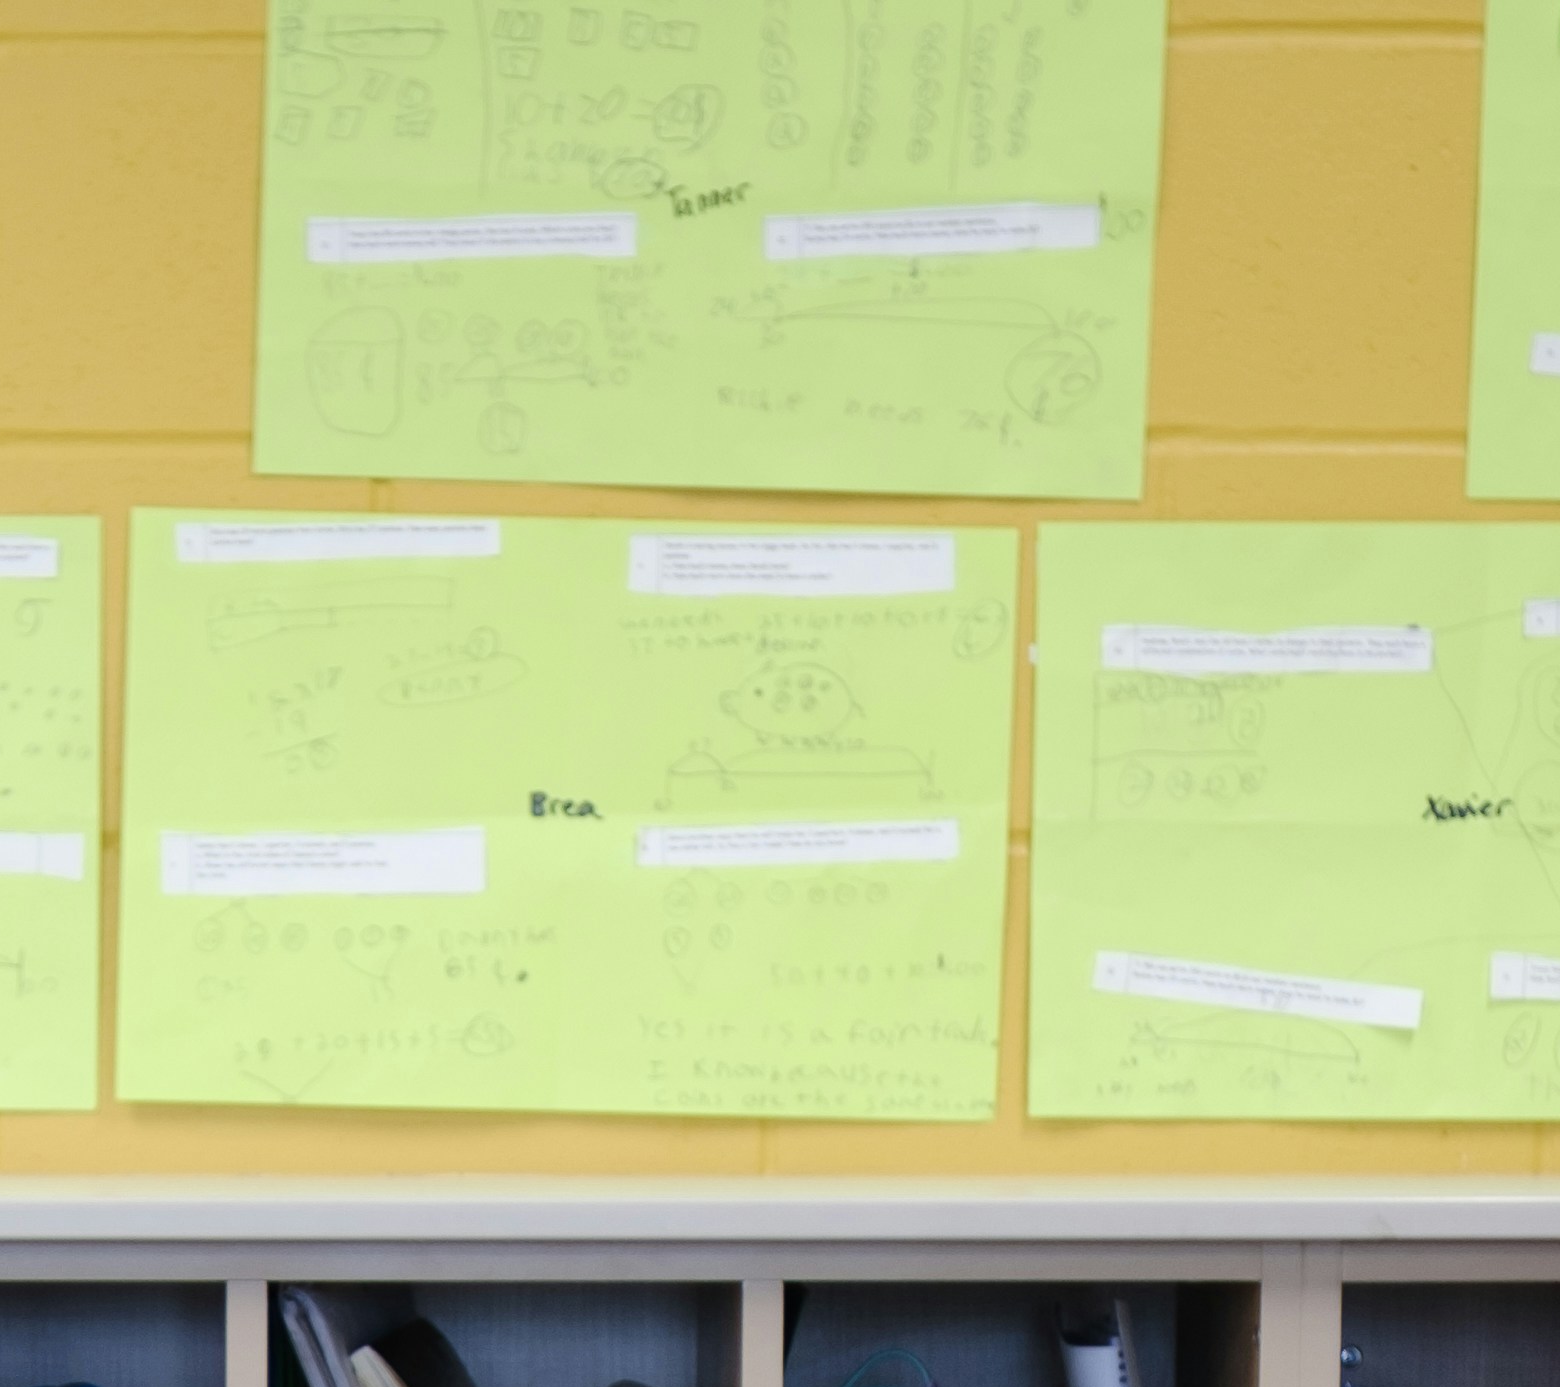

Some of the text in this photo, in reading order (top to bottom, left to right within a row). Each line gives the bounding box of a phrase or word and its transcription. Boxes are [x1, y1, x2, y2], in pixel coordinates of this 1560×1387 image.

[669, 182, 752, 218] Tanner
[530, 791, 603, 821] Brea
[1422, 793, 1514, 823] Xavier
